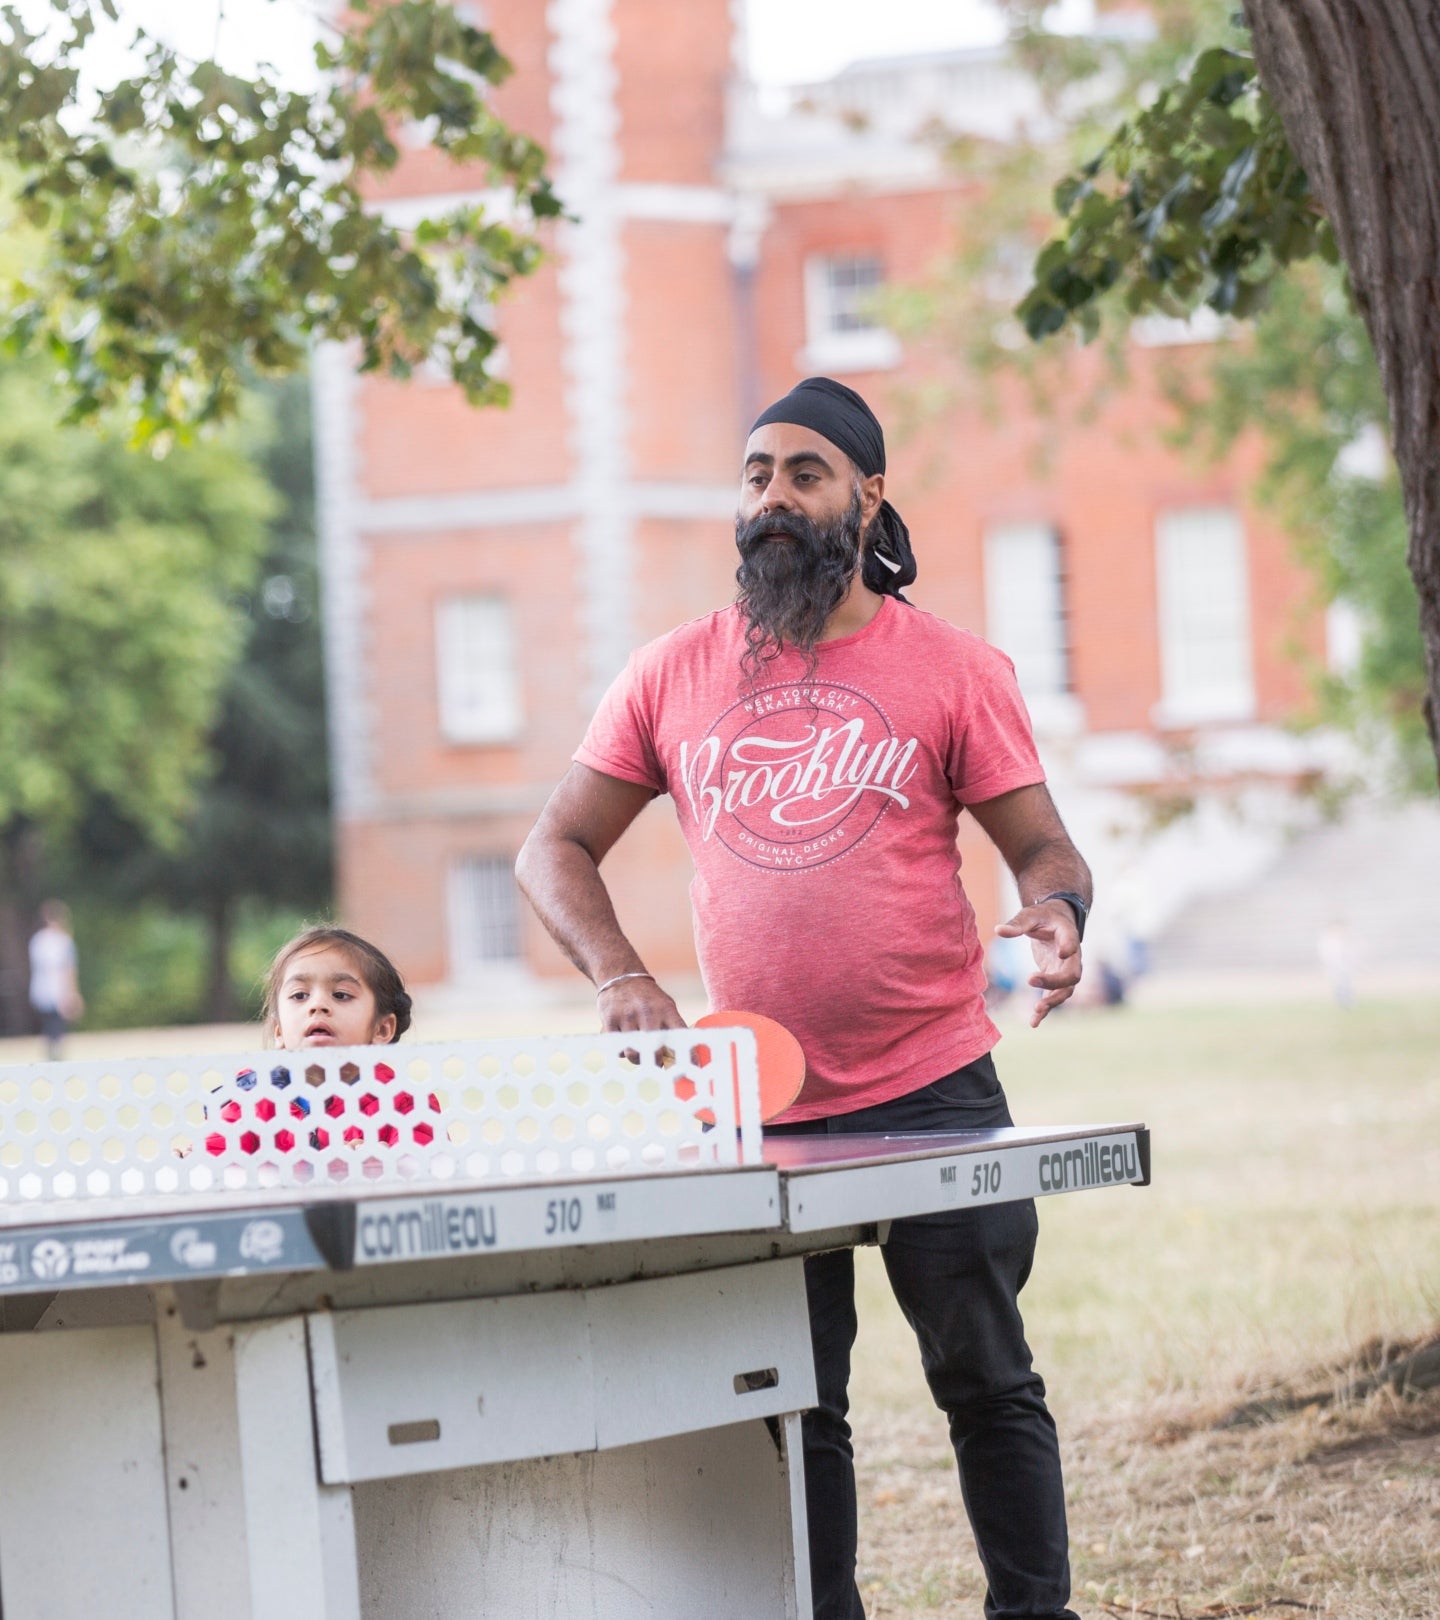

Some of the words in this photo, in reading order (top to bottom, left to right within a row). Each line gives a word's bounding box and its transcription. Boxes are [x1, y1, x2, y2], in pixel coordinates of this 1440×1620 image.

[744, 694, 773, 712] NEW
[782, 689, 821, 698] YORK
[828, 691, 858, 706] CITY
[756, 698, 801, 714] SKATE
[810, 697, 845, 711] PARK
[680, 717, 919, 842] Brooklyn
[738, 832, 796, 856] ORIGINAL
[804, 829, 845, 854] DECKS
[774, 856, 803, 865] NYC
[940, 1166, 957, 1184] MAT
[971, 1161, 1001, 1196] 510
[1038, 1141, 1137, 1192] cornilleau
[360, 1202, 496, 1257] cornilleau
[544, 1198, 582, 1235] 510
